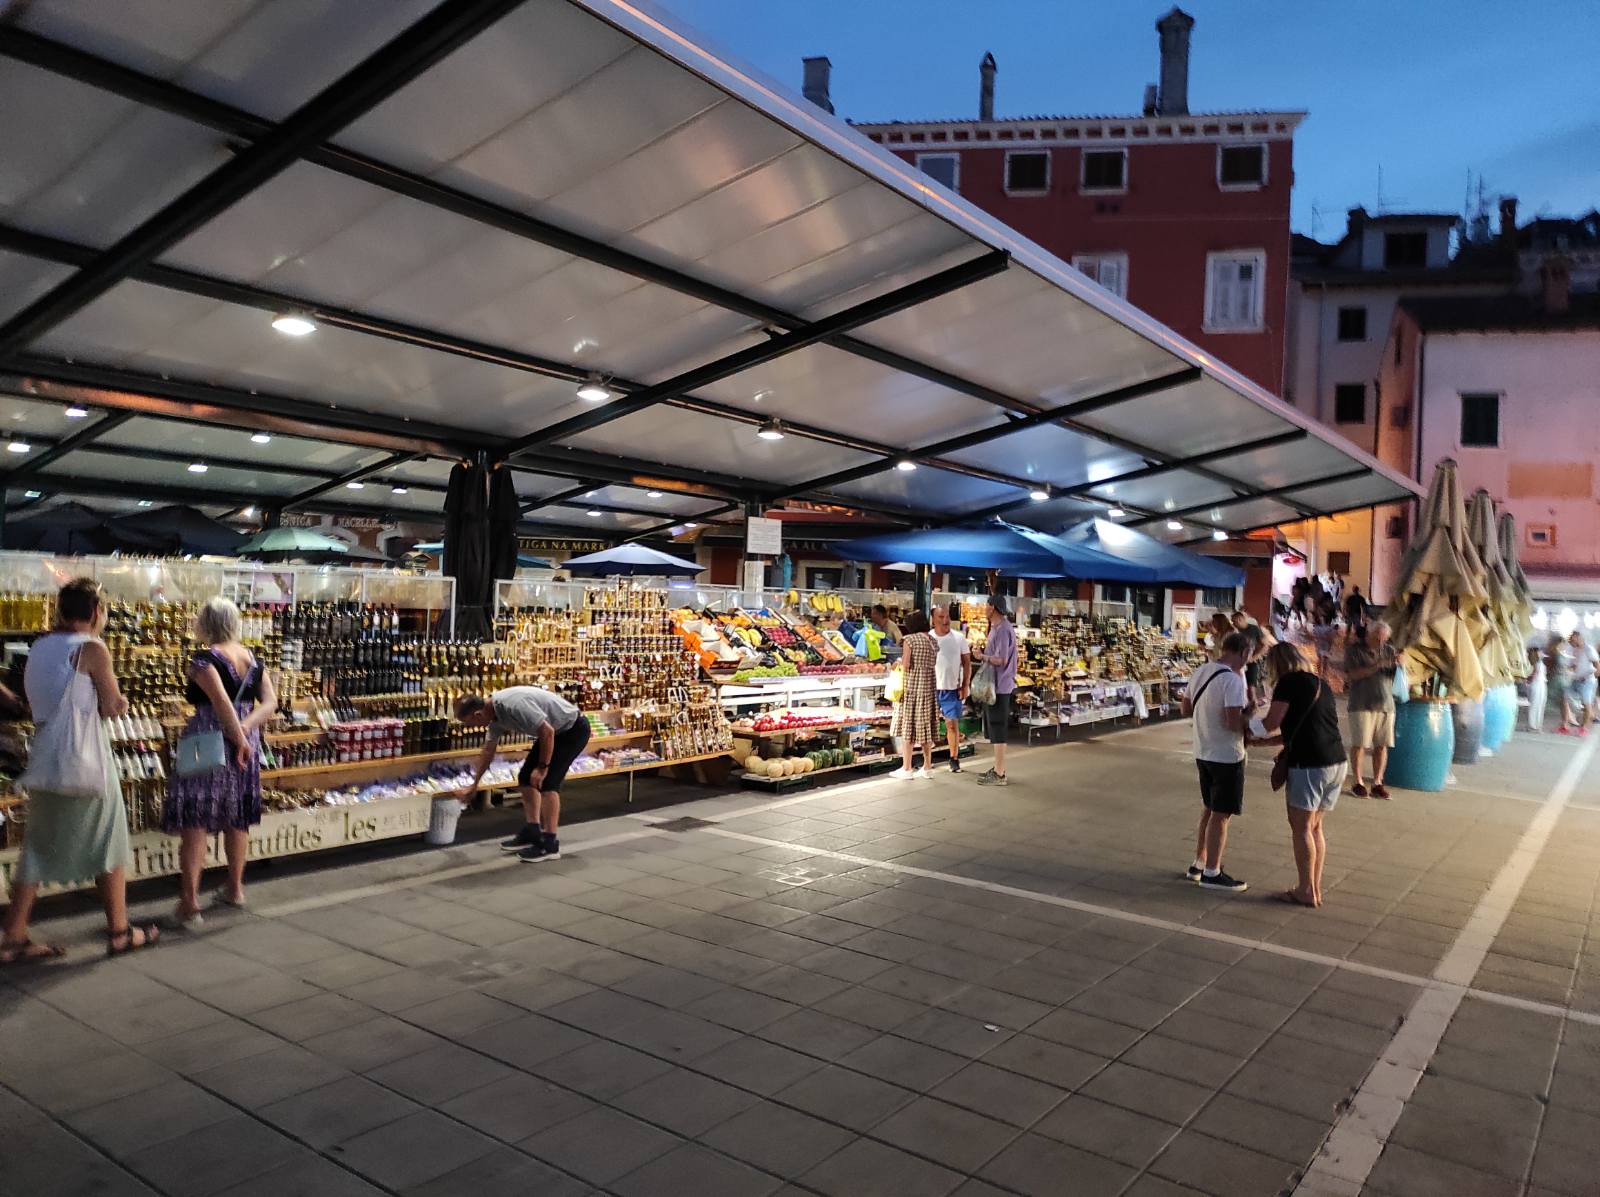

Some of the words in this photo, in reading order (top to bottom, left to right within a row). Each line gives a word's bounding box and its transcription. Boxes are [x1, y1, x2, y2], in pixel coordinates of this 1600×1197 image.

[519, 540, 547, 550] TIGA
[551, 541, 567, 550] NA
[248, 822, 322, 857] ruffles
